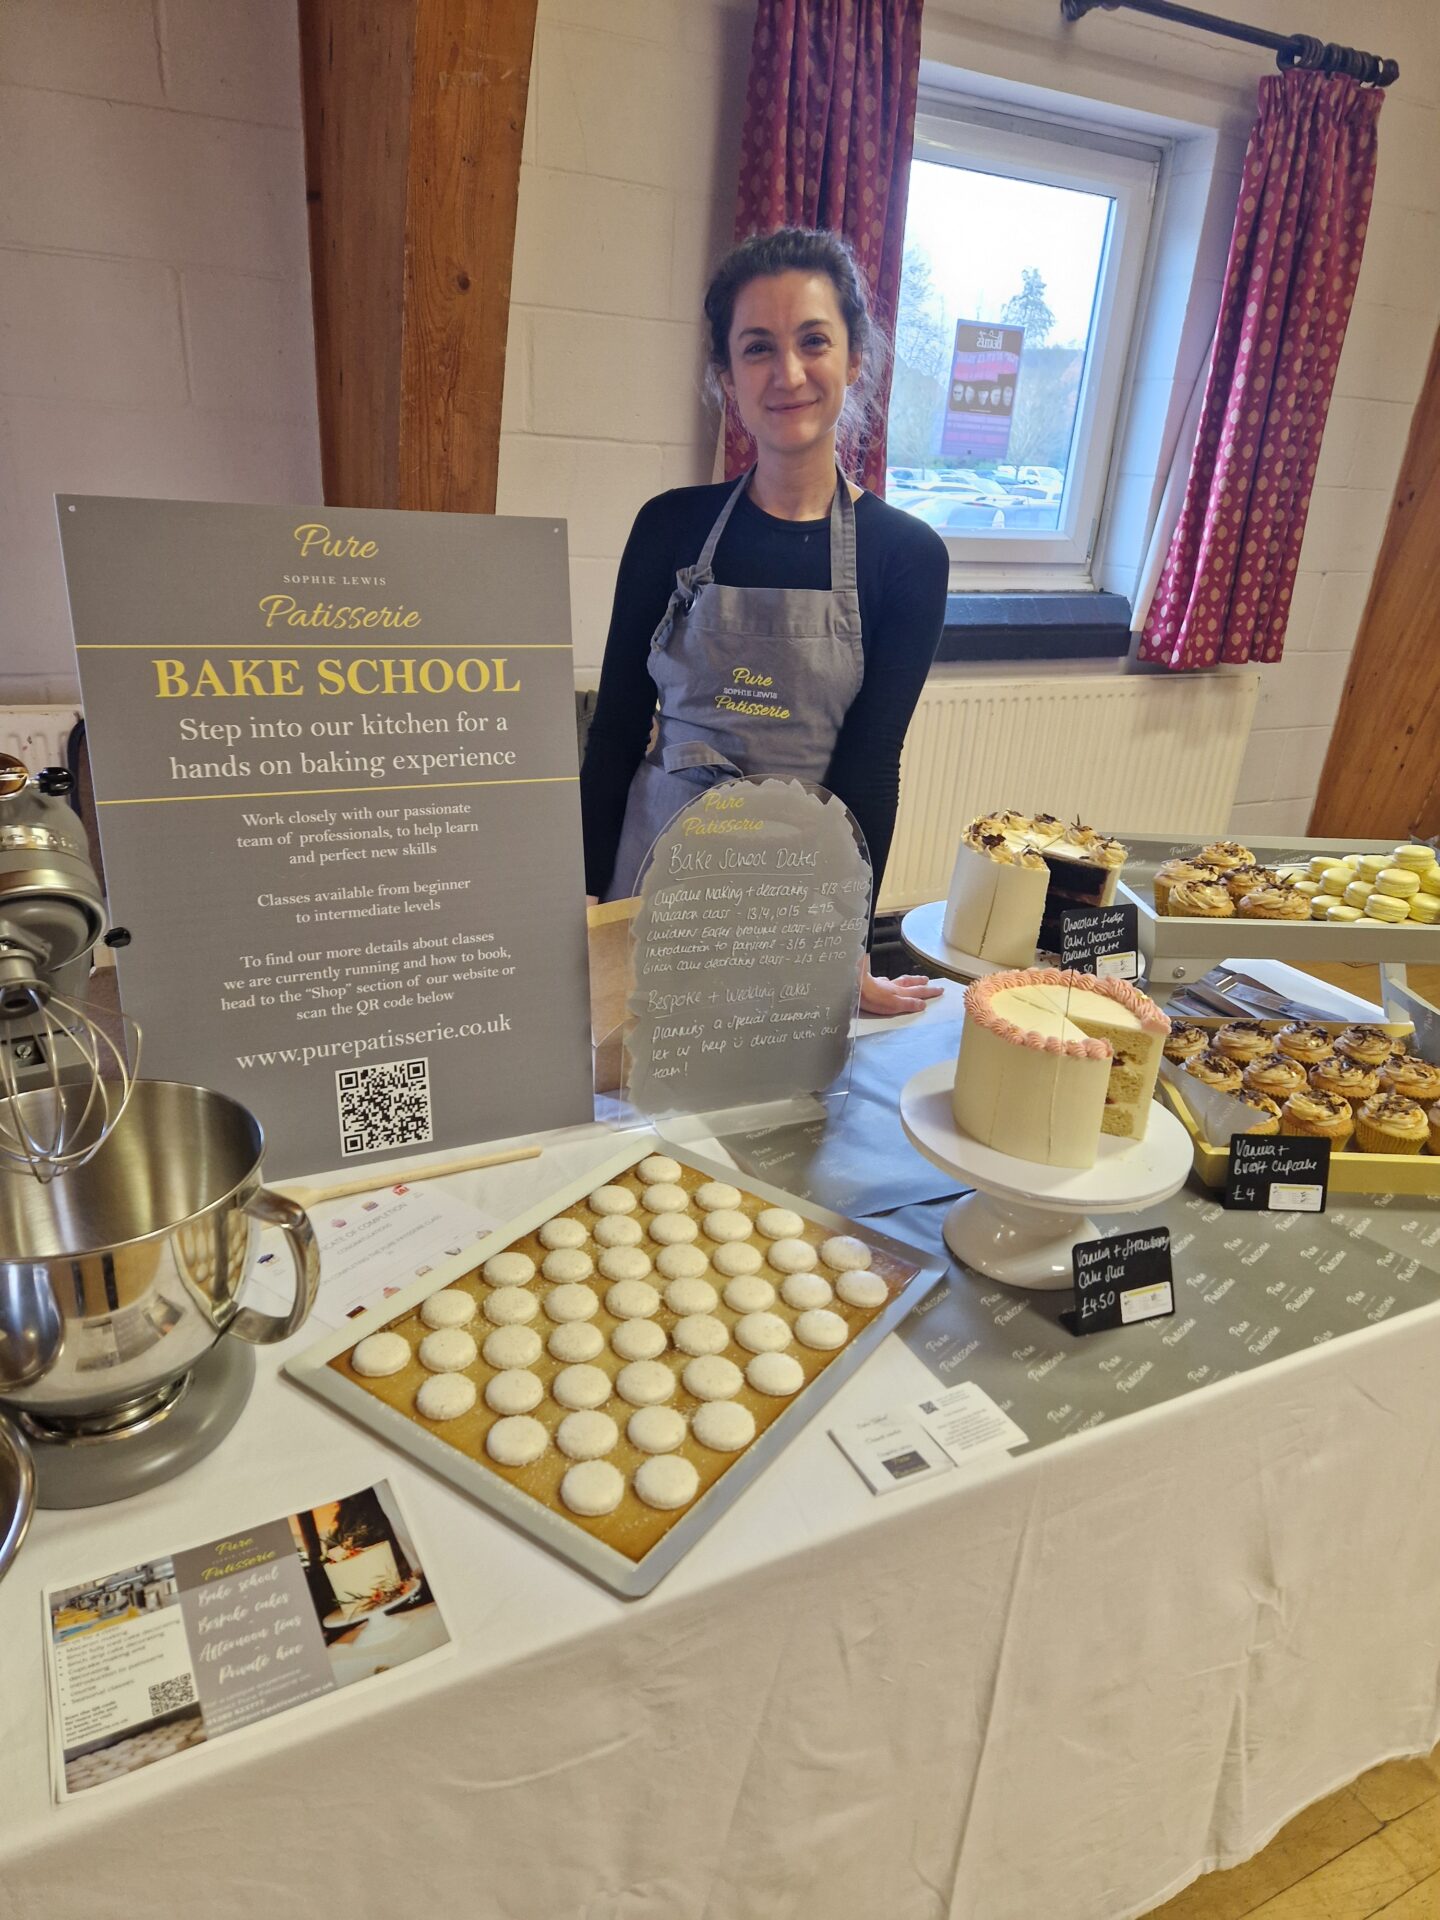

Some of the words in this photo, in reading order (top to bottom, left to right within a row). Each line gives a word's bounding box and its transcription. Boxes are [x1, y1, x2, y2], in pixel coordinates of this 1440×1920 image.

[294, 523, 379, 558] Pure
[283, 575, 336, 584] SOPHIE
[343, 577, 386, 586] LEWIS
[259, 594, 422, 629] Patisserie
[151, 658, 304, 698] BAKE
[317, 657, 521, 696] SCHOOL
[732, 667, 774, 687] Pure
[723, 687, 752, 696] SOPHIE
[753, 691, 778, 699] LEWIS
[715, 695, 790, 719] Patisserie
[179, 717, 242, 746] Step
[250, 716, 303, 738] into
[310, 721, 353, 736] our
[361, 712, 449, 735] kitchen
[456, 711, 489, 732] for
[496, 716, 508, 731] a
[169, 754, 251, 779] hands
[259, 759, 292, 776] on
[301, 750, 385, 778] baking
[393, 746, 516, 776] experience
[703, 791, 745, 811] Pure
[242, 812, 285, 827] Work
[288, 809, 337, 826] closely
[341, 806, 372, 821] with
[376, 809, 400, 819] our
[403, 803, 471, 820] passionate
[682, 816, 764, 836] Patisserie
[237, 835, 273, 848] team
[277, 832, 294, 845] of
[299, 826, 393, 847] professionals,
[396, 826, 410, 837] to
[414, 821, 442, 837] help
[445, 821, 479, 834] learn
[289, 851, 315, 865] and
[319, 848, 367, 866] perfect
[371, 847, 399, 858] new
[402, 842, 437, 855] skills
[668, 843, 711, 874] Bake
[719, 848, 766, 869] School
[776, 848, 820, 868] Dates
[257, 893, 311, 908] Classes
[314, 885, 374, 903] available
[377, 883, 410, 897] from
[413, 878, 471, 895] beginner
[296, 912, 311, 924] to
[314, 903, 400, 922] intermediate
[404, 899, 441, 913] levels
[703, 909, 731, 919] class
[240, 955, 262, 968] To
[265, 951, 294, 967] find
[297, 951, 322, 963] our
[326, 946, 362, 960] more
[365, 940, 409, 955] details
[412, 936, 448, 950] about
[451, 931, 495, 945] classes
[715, 942, 727, 950] to
[223, 980, 245, 990] we
[248, 977, 272, 988] are
[275, 966, 341, 985] currently
[345, 960, 400, 976] running
[403, 956, 427, 970] and
[430, 953, 457, 967] how
[461, 952, 474, 963] to
[478, 946, 512, 960] book,
[220, 996, 255, 1011] head
[260, 994, 275, 1006] to
[279, 990, 302, 1004] the
[356, 979, 403, 994] section
[406, 974, 422, 987] of
[426, 973, 449, 985] our
[452, 966, 499, 982] website
[502, 965, 516, 975] or
[296, 1008, 327, 1021] scan
[331, 1002, 353, 1016] the
[356, 999, 380, 1016] QR
[383, 995, 414, 1010] code
[417, 991, 455, 1005] below
[713, 1019, 722, 1029] a
[236, 1013, 513, 1070] www.purepatisserie.co.uk
[1232, 1184, 1255, 1201] £4
[1082, 1291, 1115, 1319] £4.50
[238, 1566, 279, 1593] school
